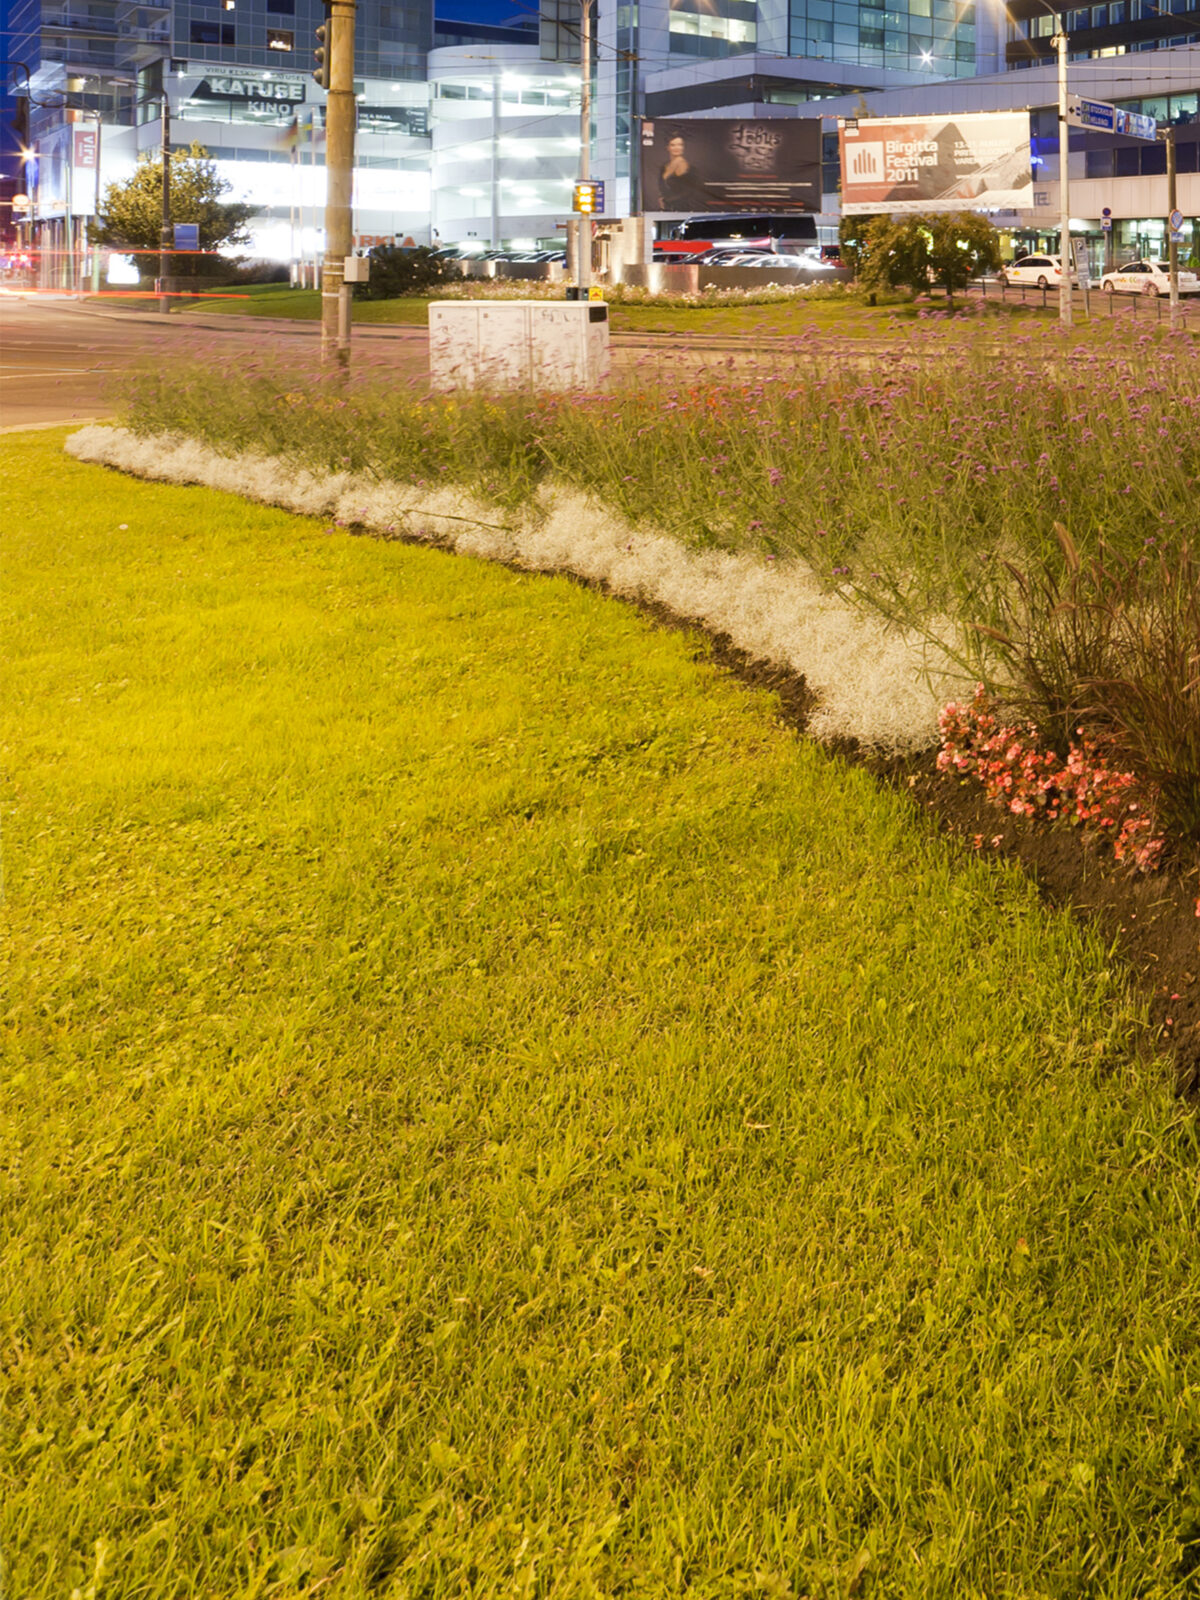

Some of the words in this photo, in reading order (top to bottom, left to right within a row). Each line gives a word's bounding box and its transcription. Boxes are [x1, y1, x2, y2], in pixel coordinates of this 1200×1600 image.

[211, 78, 304, 100] KATUSE
[247, 101, 291, 115] KINO
[82, 135, 94, 165] viru
[886, 140, 939, 157] Birgitta
[886, 153, 938, 168] Festival
[886, 168, 919, 182] 2011
